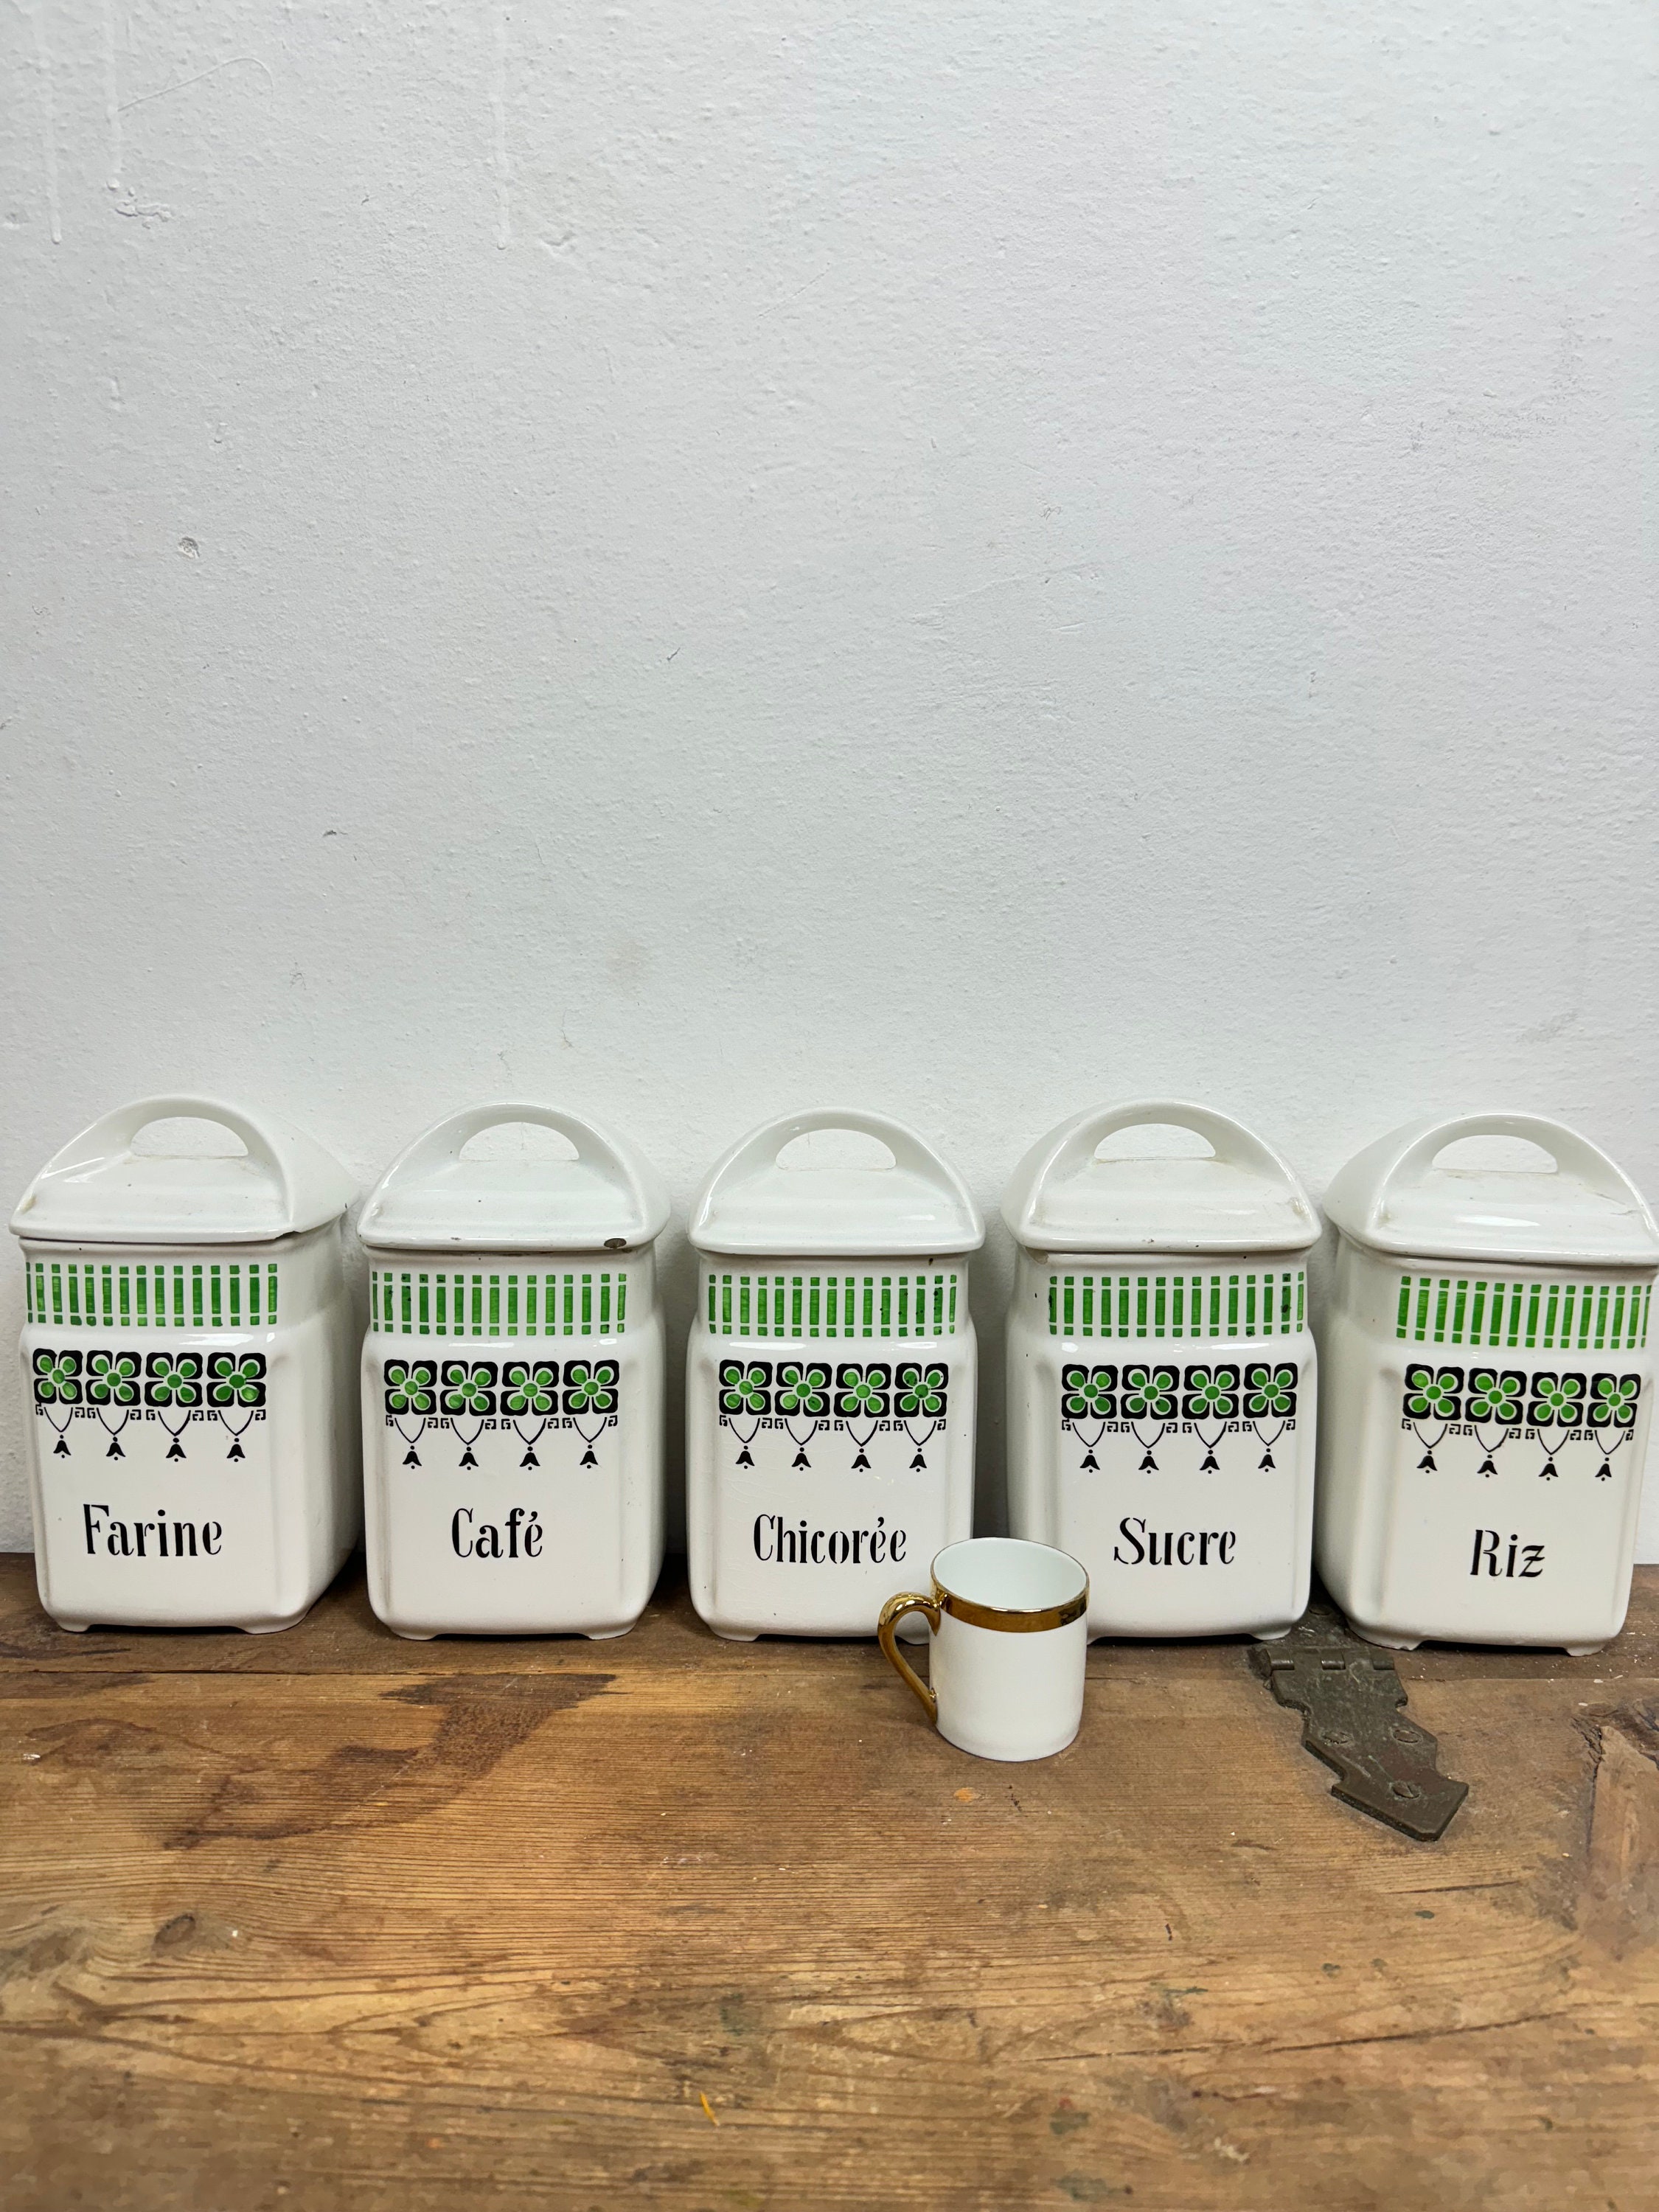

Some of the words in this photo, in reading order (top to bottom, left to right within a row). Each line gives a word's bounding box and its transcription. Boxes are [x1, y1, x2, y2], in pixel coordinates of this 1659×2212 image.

[83, 1503, 223, 1557] Farine
[451, 1507, 543, 1559] Café
[753, 1514, 907, 1565] Chicorée
[1113, 1517, 1237, 1567] Sucre
[1470, 1529, 1546, 1578] Riz
